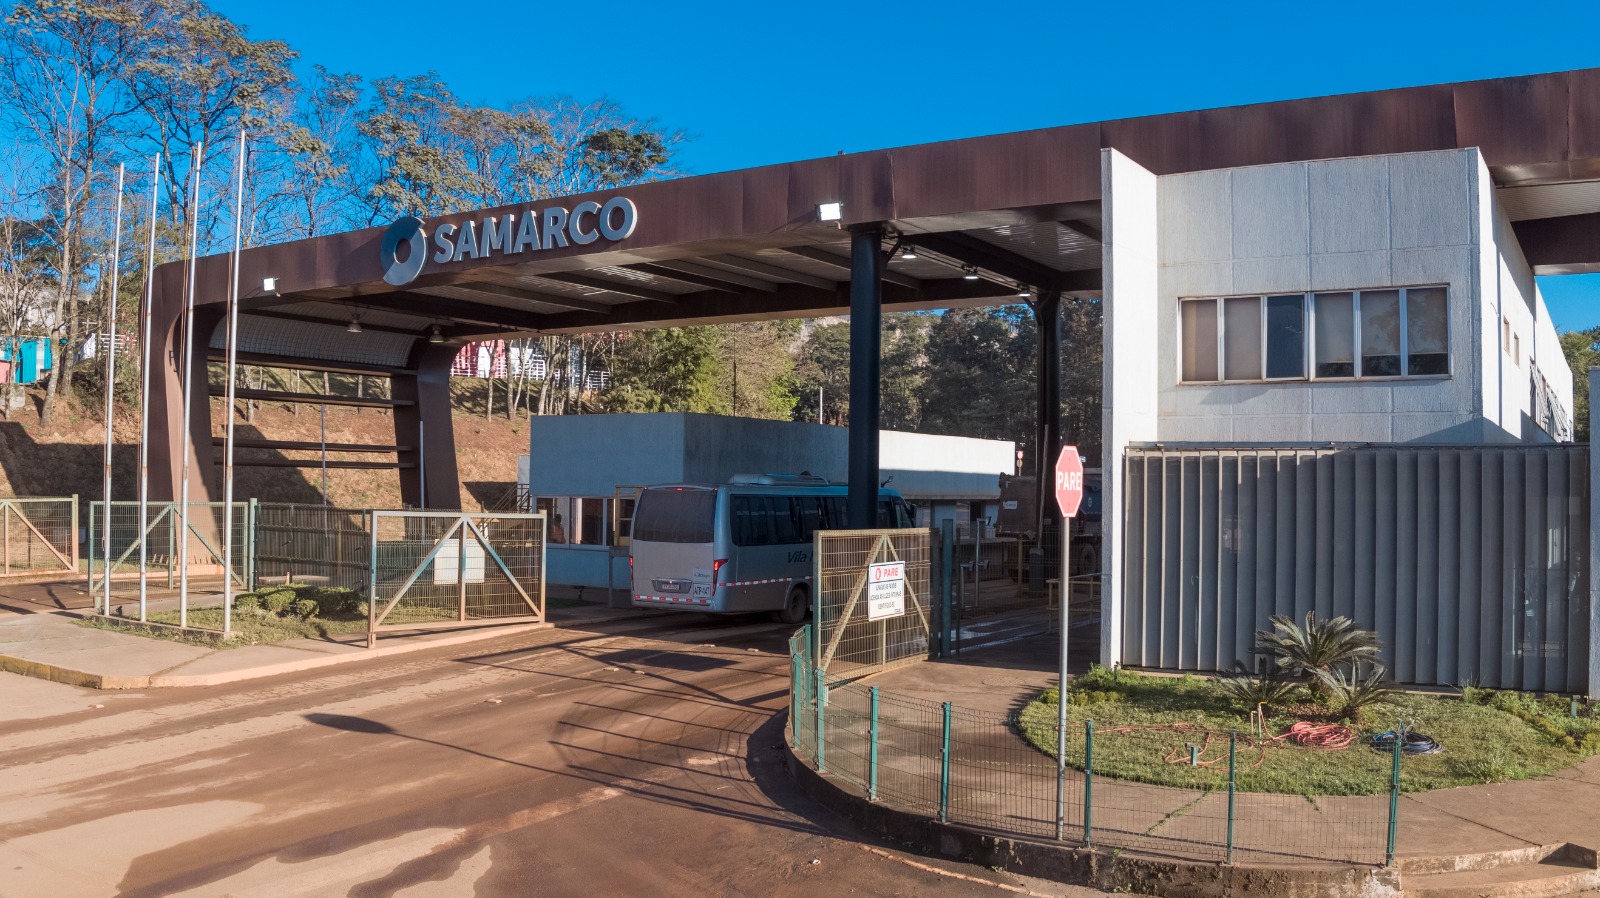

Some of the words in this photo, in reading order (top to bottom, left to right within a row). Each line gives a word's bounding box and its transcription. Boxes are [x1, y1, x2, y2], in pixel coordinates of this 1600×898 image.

[433, 196, 638, 264] SAMARCO
[1057, 471, 1081, 491] PARE
[787, 551, 807, 563] Vila
[883, 567, 899, 577] PARE
